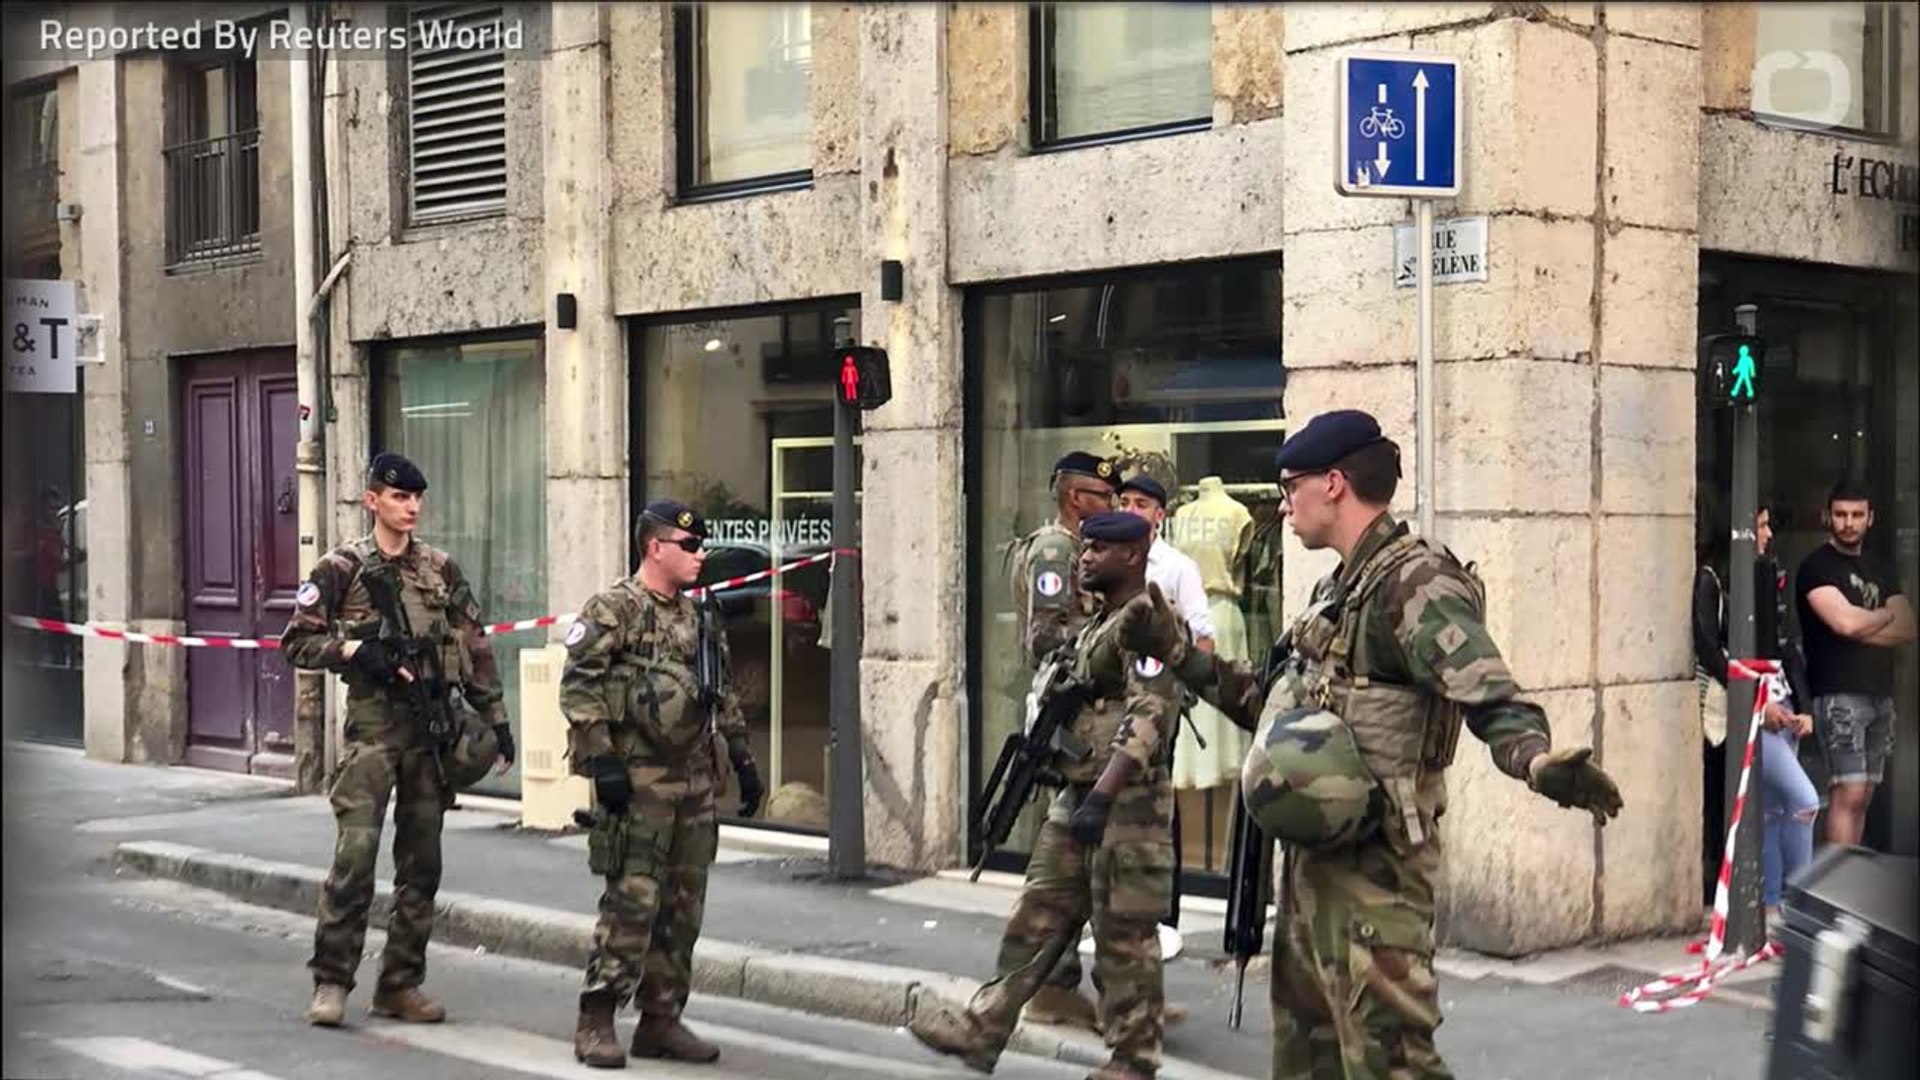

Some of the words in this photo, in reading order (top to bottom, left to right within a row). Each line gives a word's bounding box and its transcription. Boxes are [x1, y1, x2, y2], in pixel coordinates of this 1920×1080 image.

[1431, 250, 1480, 276] ÉLÈNE
[9, 295, 49, 308] MAN
[703, 519, 756, 542] ENTES
